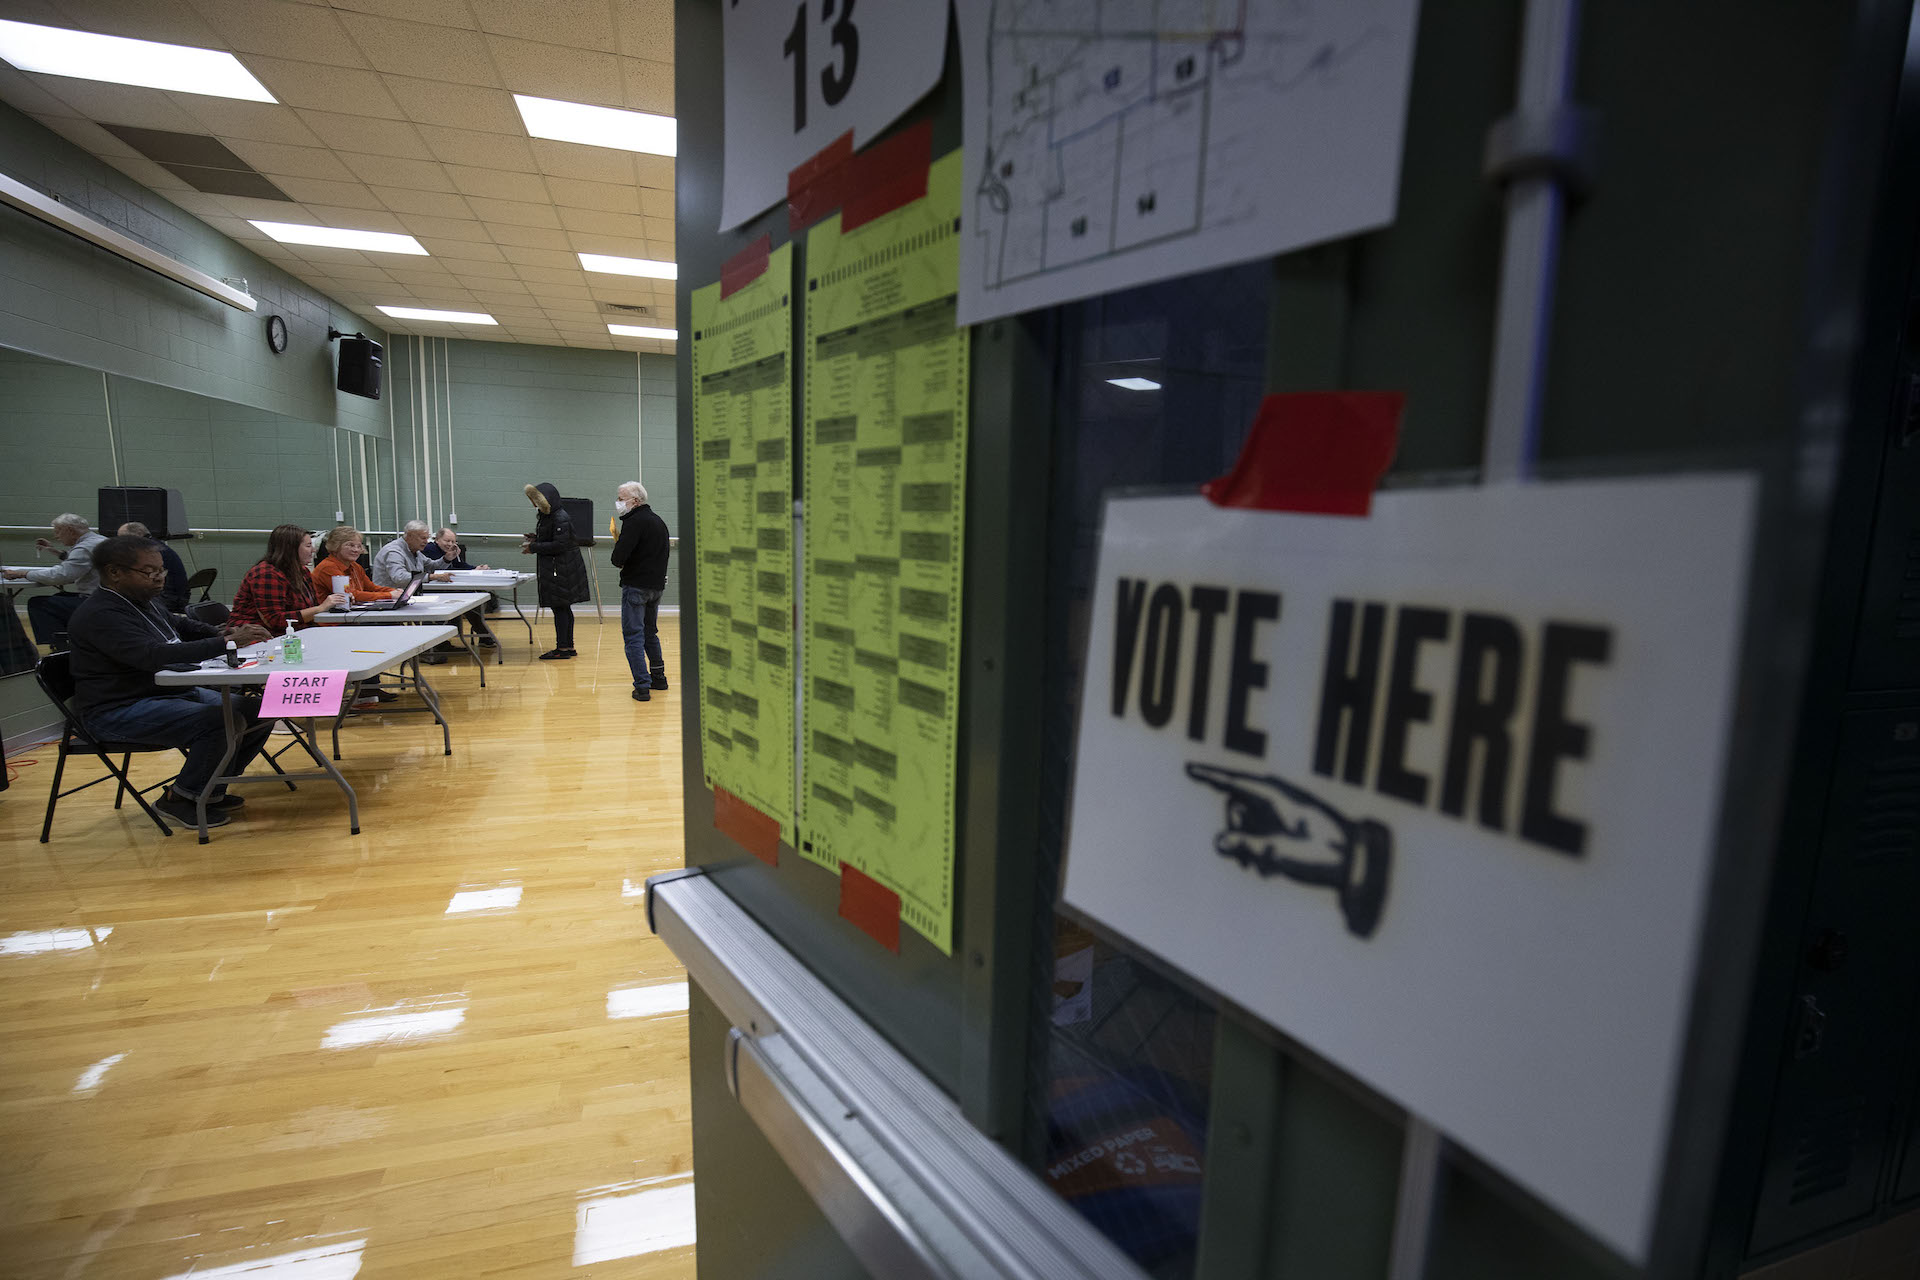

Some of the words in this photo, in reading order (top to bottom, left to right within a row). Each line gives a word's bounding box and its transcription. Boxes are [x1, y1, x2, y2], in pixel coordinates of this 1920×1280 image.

[784, 0, 859, 134] 13
[282, 677, 329, 687] START
[282, 693, 321, 704] HERE
[1111, 576, 1282, 759] VOTE
[1312, 597, 1615, 858] HERE
[1048, 1145, 1105, 1179] MIXED
[1103, 1128, 1158, 1152] PAPER
